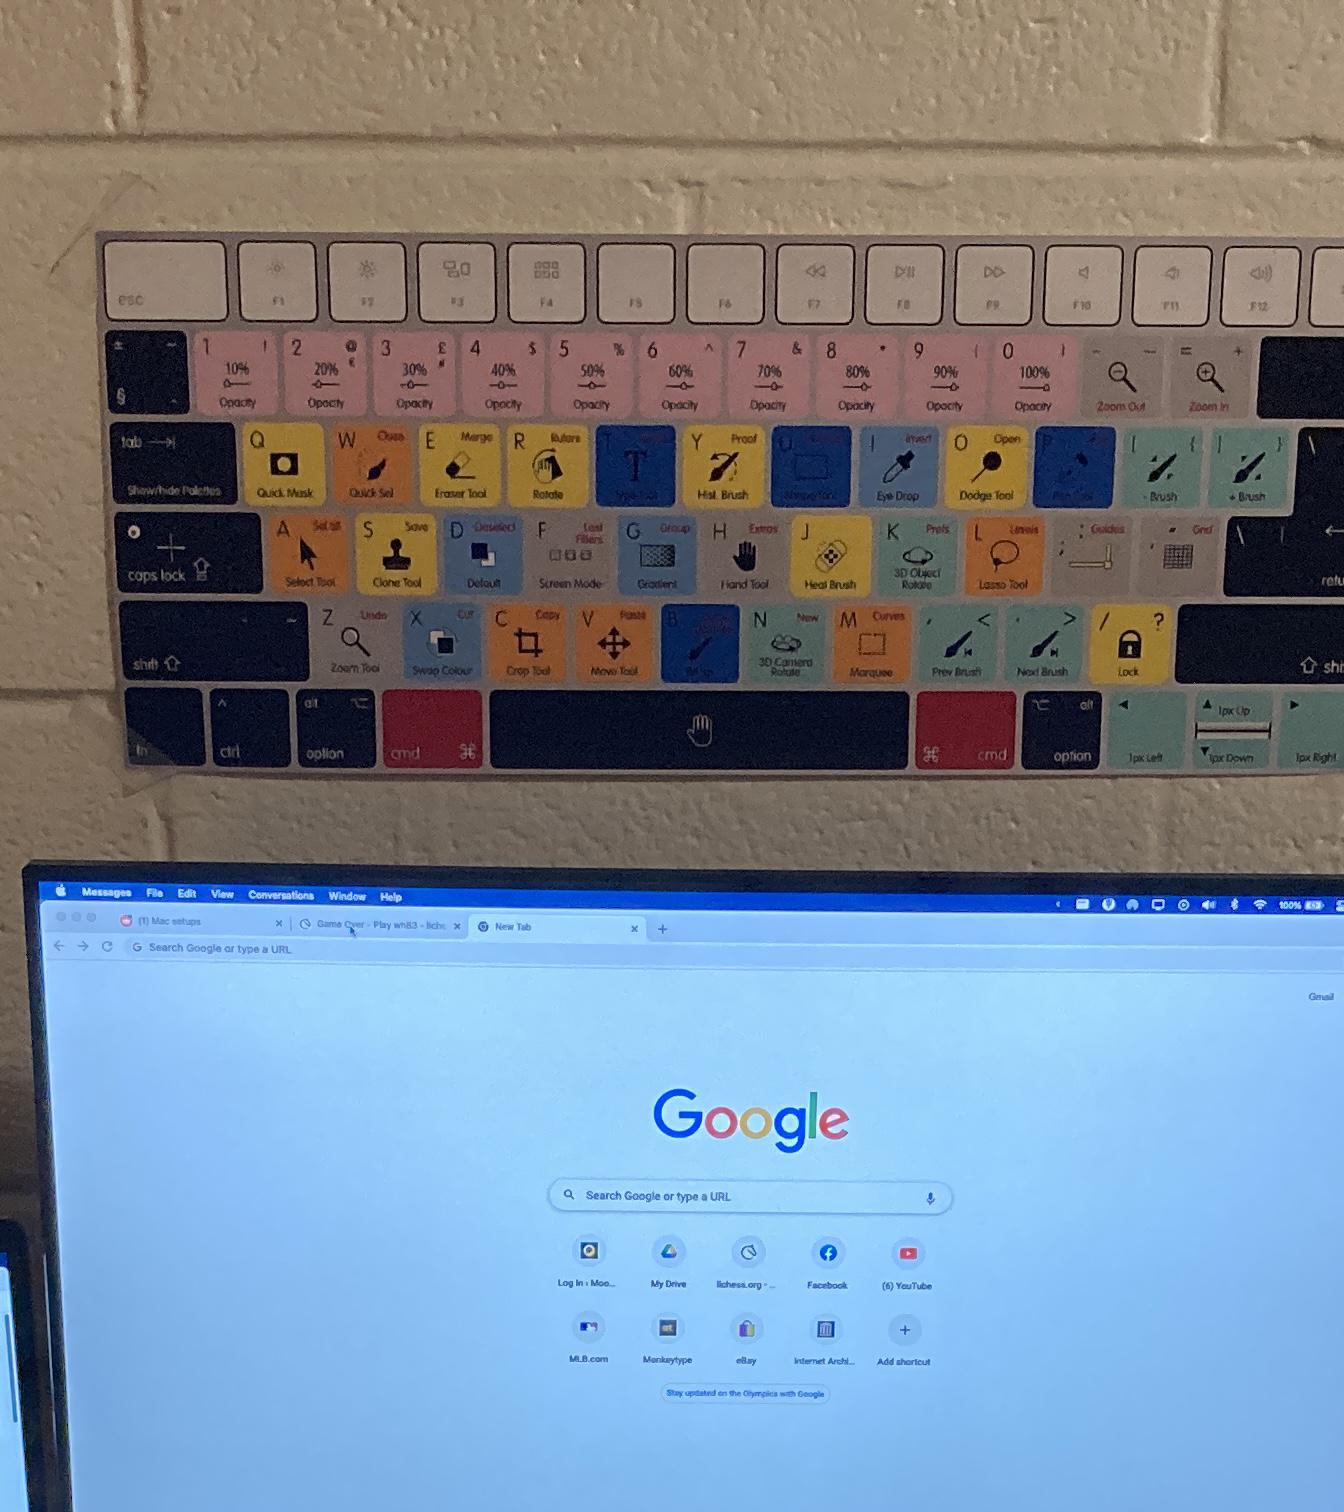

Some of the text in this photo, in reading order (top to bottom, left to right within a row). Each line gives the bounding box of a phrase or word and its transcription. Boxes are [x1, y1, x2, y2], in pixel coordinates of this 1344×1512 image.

[225, 362, 250, 376] 10%
[313, 362, 339, 376] 20%
[402, 363, 428, 377] 30%
[491, 363, 517, 377] 40%
[580, 364, 606, 378] 50%
[668, 364, 694, 378] 60%
[757, 364, 782, 379] 70%
[845, 364, 871, 379] 80%
[933, 364, 958, 379] 90%
[1020, 365, 1050, 379] 100%
[219, 397, 256, 410] Opacity
[307, 397, 345, 410] Opacity
[396, 398, 434, 411] Opacity
[485, 399, 522, 412] Opacity
[573, 399, 610, 412] Opacity
[661, 400, 698, 412] Opacity
[749, 399, 786, 412] Opacity
[838, 400, 875, 412] Opacity
[926, 400, 963, 412] Opacity
[1014, 400, 1052, 412] Opacity
[1096, 401, 1126, 412] Zoom
[1188, 401, 1229, 412] Zoom In
[994, 433, 1021, 445] Open
[257, 487, 284, 498] Quick
[467, 489, 487, 499] Tool
[533, 490, 563, 500] Rotate
[721, 490, 749, 500] Brush
[895, 491, 919, 502] Drop
[959, 490, 1013, 501] Dodge Tool
[1150, 492, 1178, 502] Brush
[1238, 492, 1266, 502] Brush
[127, 569, 185, 584] caps lock
[372, 577, 422, 588] Clone Tool
[467, 579, 501, 589] Default
[539, 579, 602, 589] Screen Mode
[720, 579, 769, 590] Hand Tool
[829, 580, 856, 590] Brush
[1009, 580, 1028, 590] Tool
[532, 666, 551, 676] Tool
[620, 667, 638, 676] Tool
[850, 668, 893, 679] Marquee
[932, 667, 981, 677] Prev Brush
[1041, 667, 1068, 677] Brush
[1118, 667, 1139, 677] Lock
[306, 747, 344, 761] option
[391, 747, 420, 760] cmd
[978, 748, 1007, 761] cmd
[82, 887, 402, 903] Messages File Edit View Conversations Window Help
[1279, 900, 1302, 911] 100%
[152, 917, 201, 929] Mac setups
[317, 919, 342, 929] Game
[373, 919, 392, 932] Play
[495, 922, 532, 932] New Tab
[149, 942, 184, 953] Search
[186, 942, 222, 955] Google
[225, 944, 234, 954] or
[237, 944, 259, 956] type
[271, 944, 292, 955] URL
[1309, 992, 1334, 1002] Gmail
[653, 1088, 850, 1153] Google
[586, 1190, 622, 1202] Search
[624, 1190, 660, 1204] Google
[663, 1192, 674, 1202] or
[676, 1191, 698, 1204] type
[710, 1191, 731, 1202] URL
[558, 1279, 574, 1288] Log
[651, 1280, 687, 1289] My Drive
[716, 1281, 762, 1290] lichess.org
[807, 1281, 848, 1290] Facebook
[896, 1282, 932, 1290] YouTube
[569, 1355, 609, 1363] MLB.com
[642, 1356, 693, 1365] Monkeytype
[736, 1357, 757, 1366] eBay
[794, 1357, 825, 1365] Internet
[877, 1358, 931, 1366] Add shortcut
